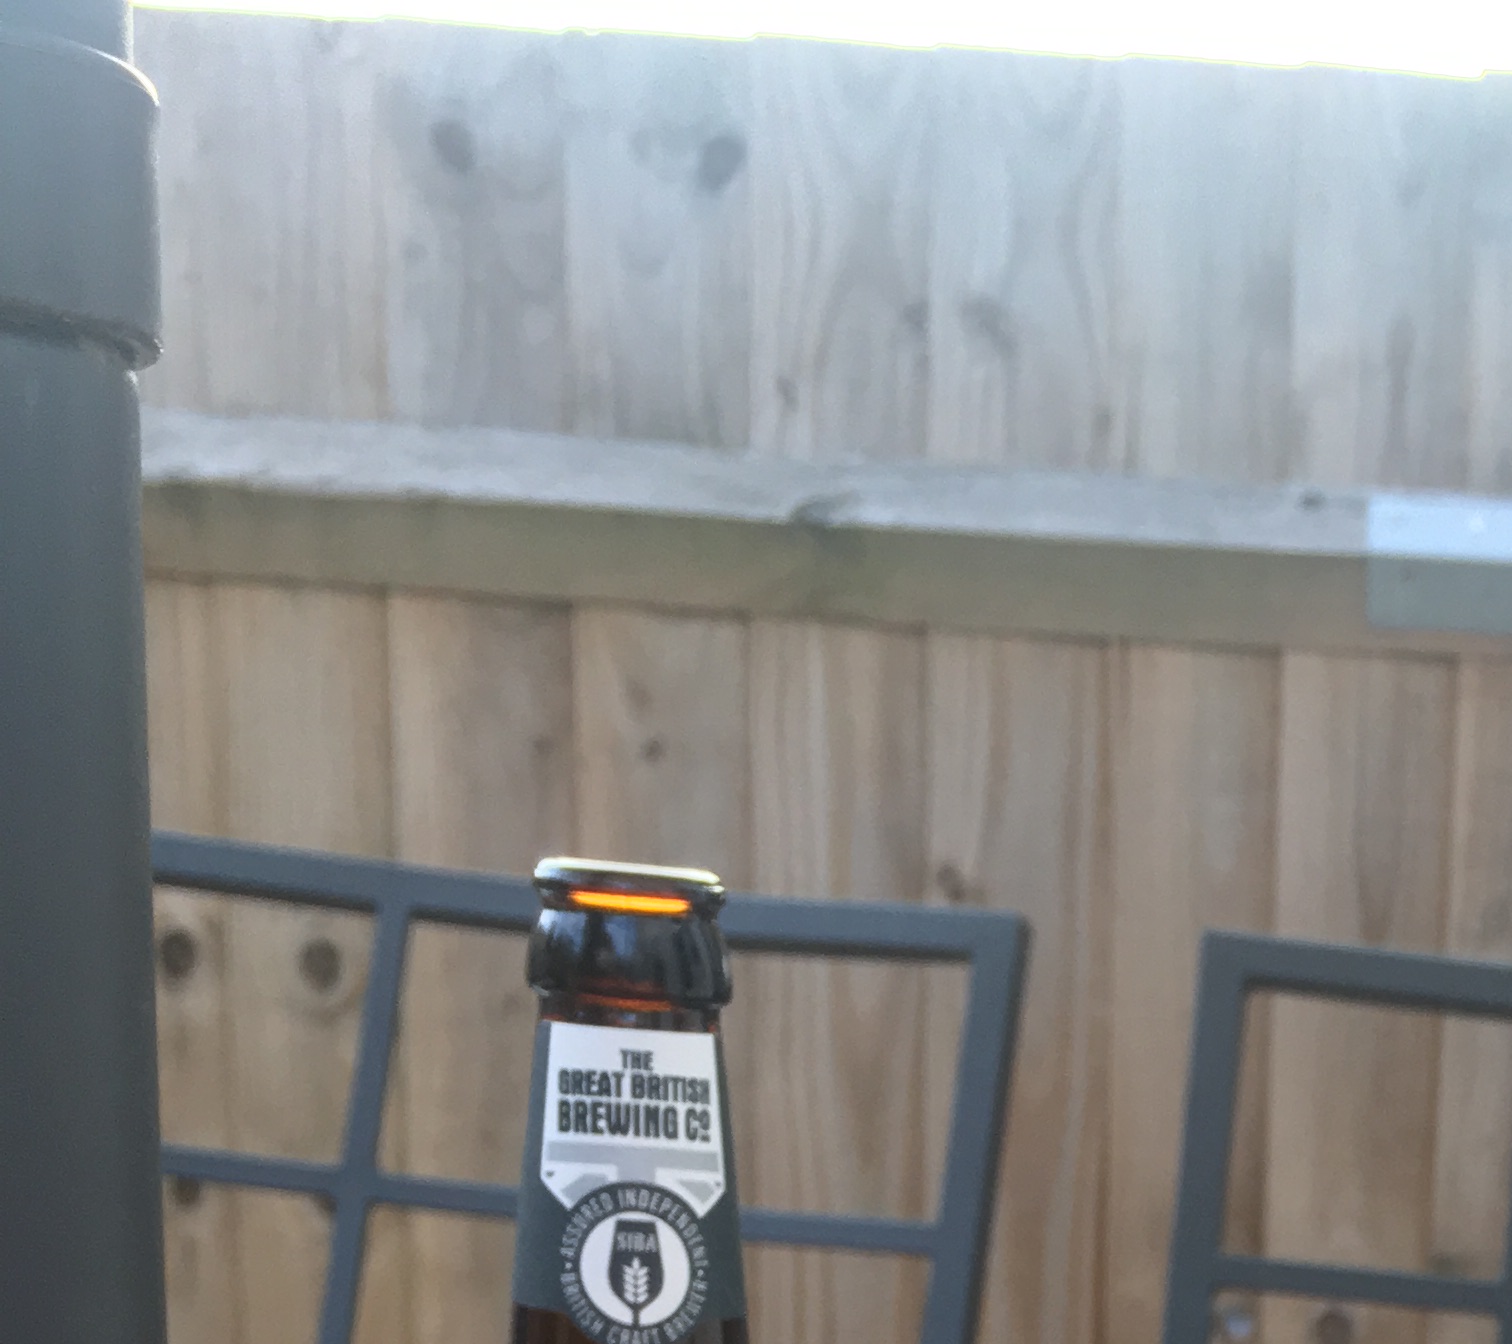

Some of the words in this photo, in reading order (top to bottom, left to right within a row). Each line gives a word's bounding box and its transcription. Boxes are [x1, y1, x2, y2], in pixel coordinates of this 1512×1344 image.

[620, 1049, 653, 1070] THE
[558, 1067, 624, 1097] GREAT
[631, 1073, 710, 1105] BRITISH
[558, 1099, 678, 1139] BREWING
